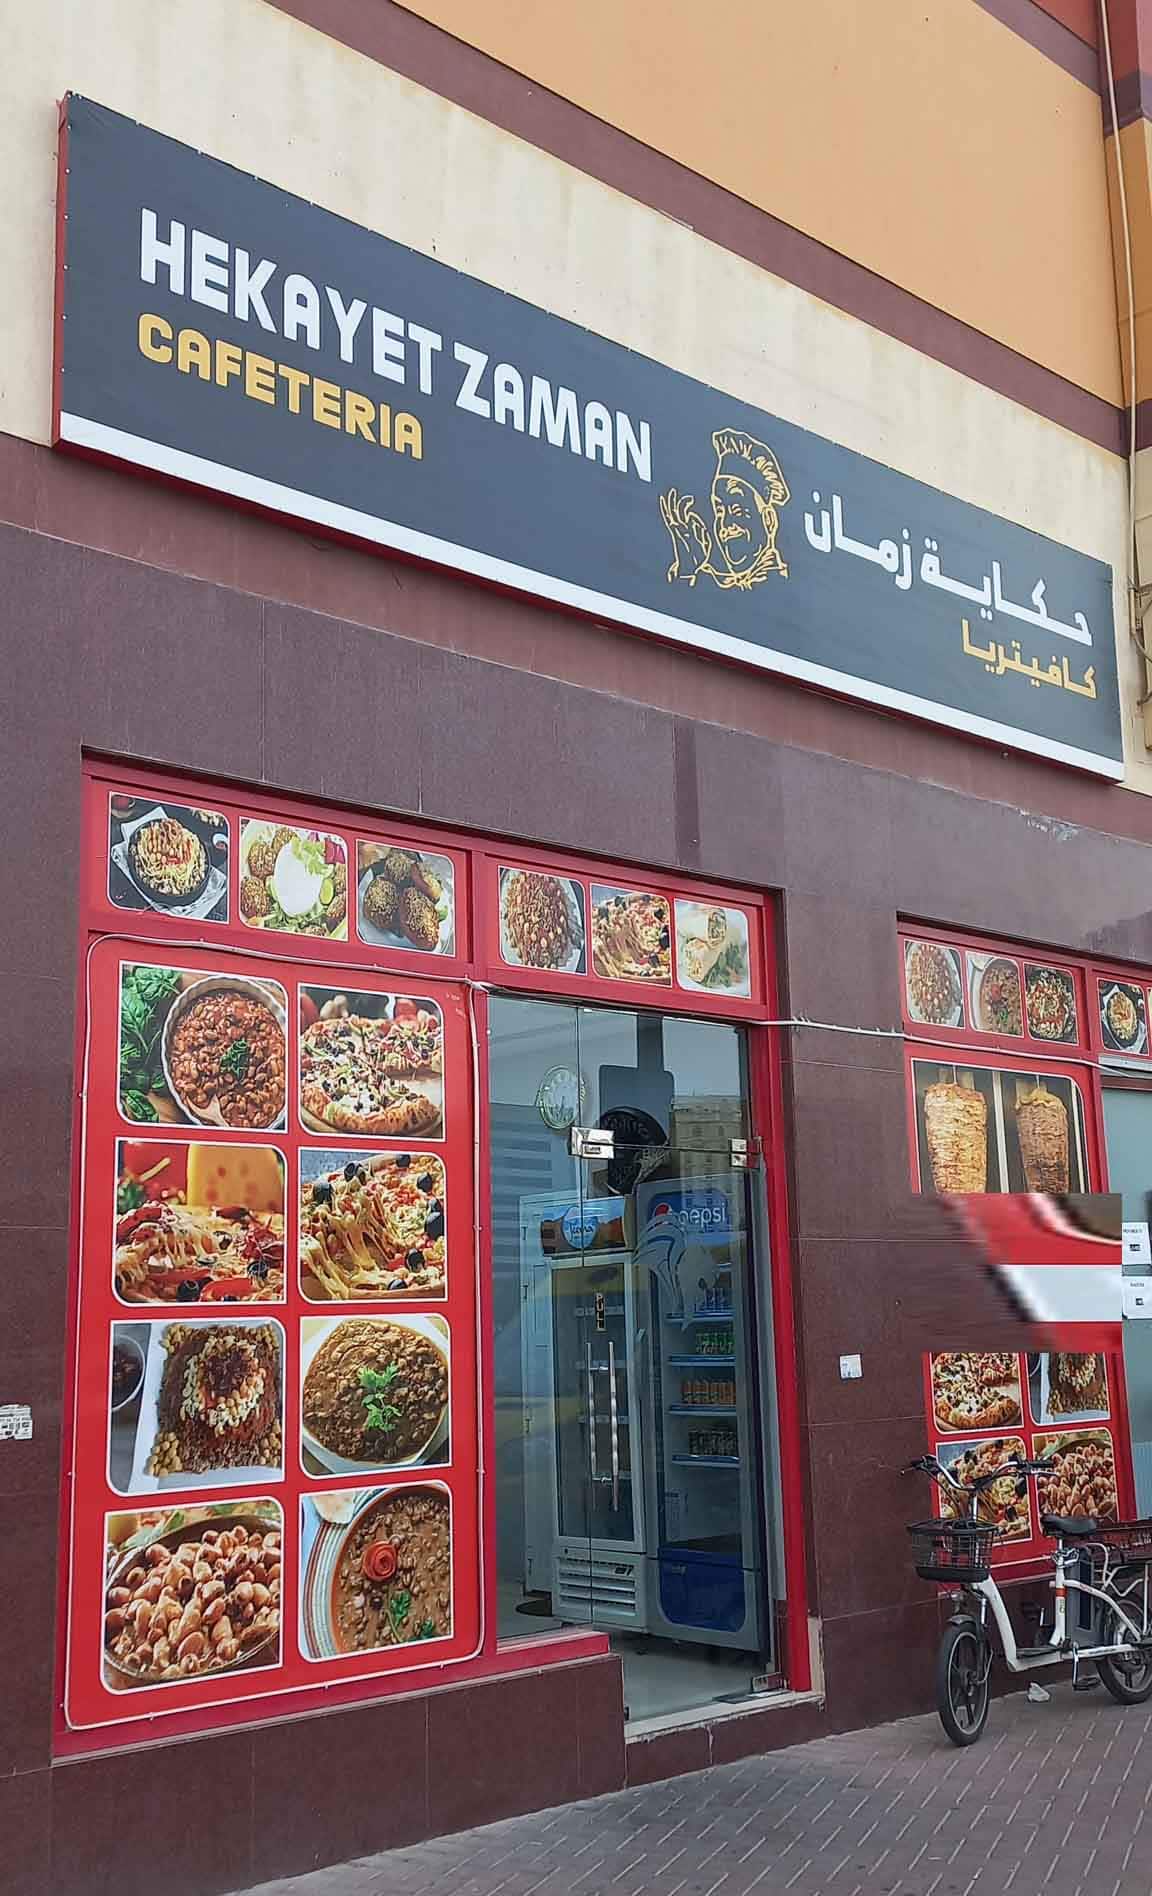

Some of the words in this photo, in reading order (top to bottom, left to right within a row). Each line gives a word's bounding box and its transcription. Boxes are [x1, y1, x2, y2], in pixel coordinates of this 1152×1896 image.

[138, 313, 423, 459] CAFETERIA
[140, 208, 442, 395] HEKAYET
[454, 341, 653, 483] ZAMAN
[804, 491, 912, 590] زمان
[920, 536, 1093, 647] حكاية
[962, 617, 1097, 699] كافيتريا
